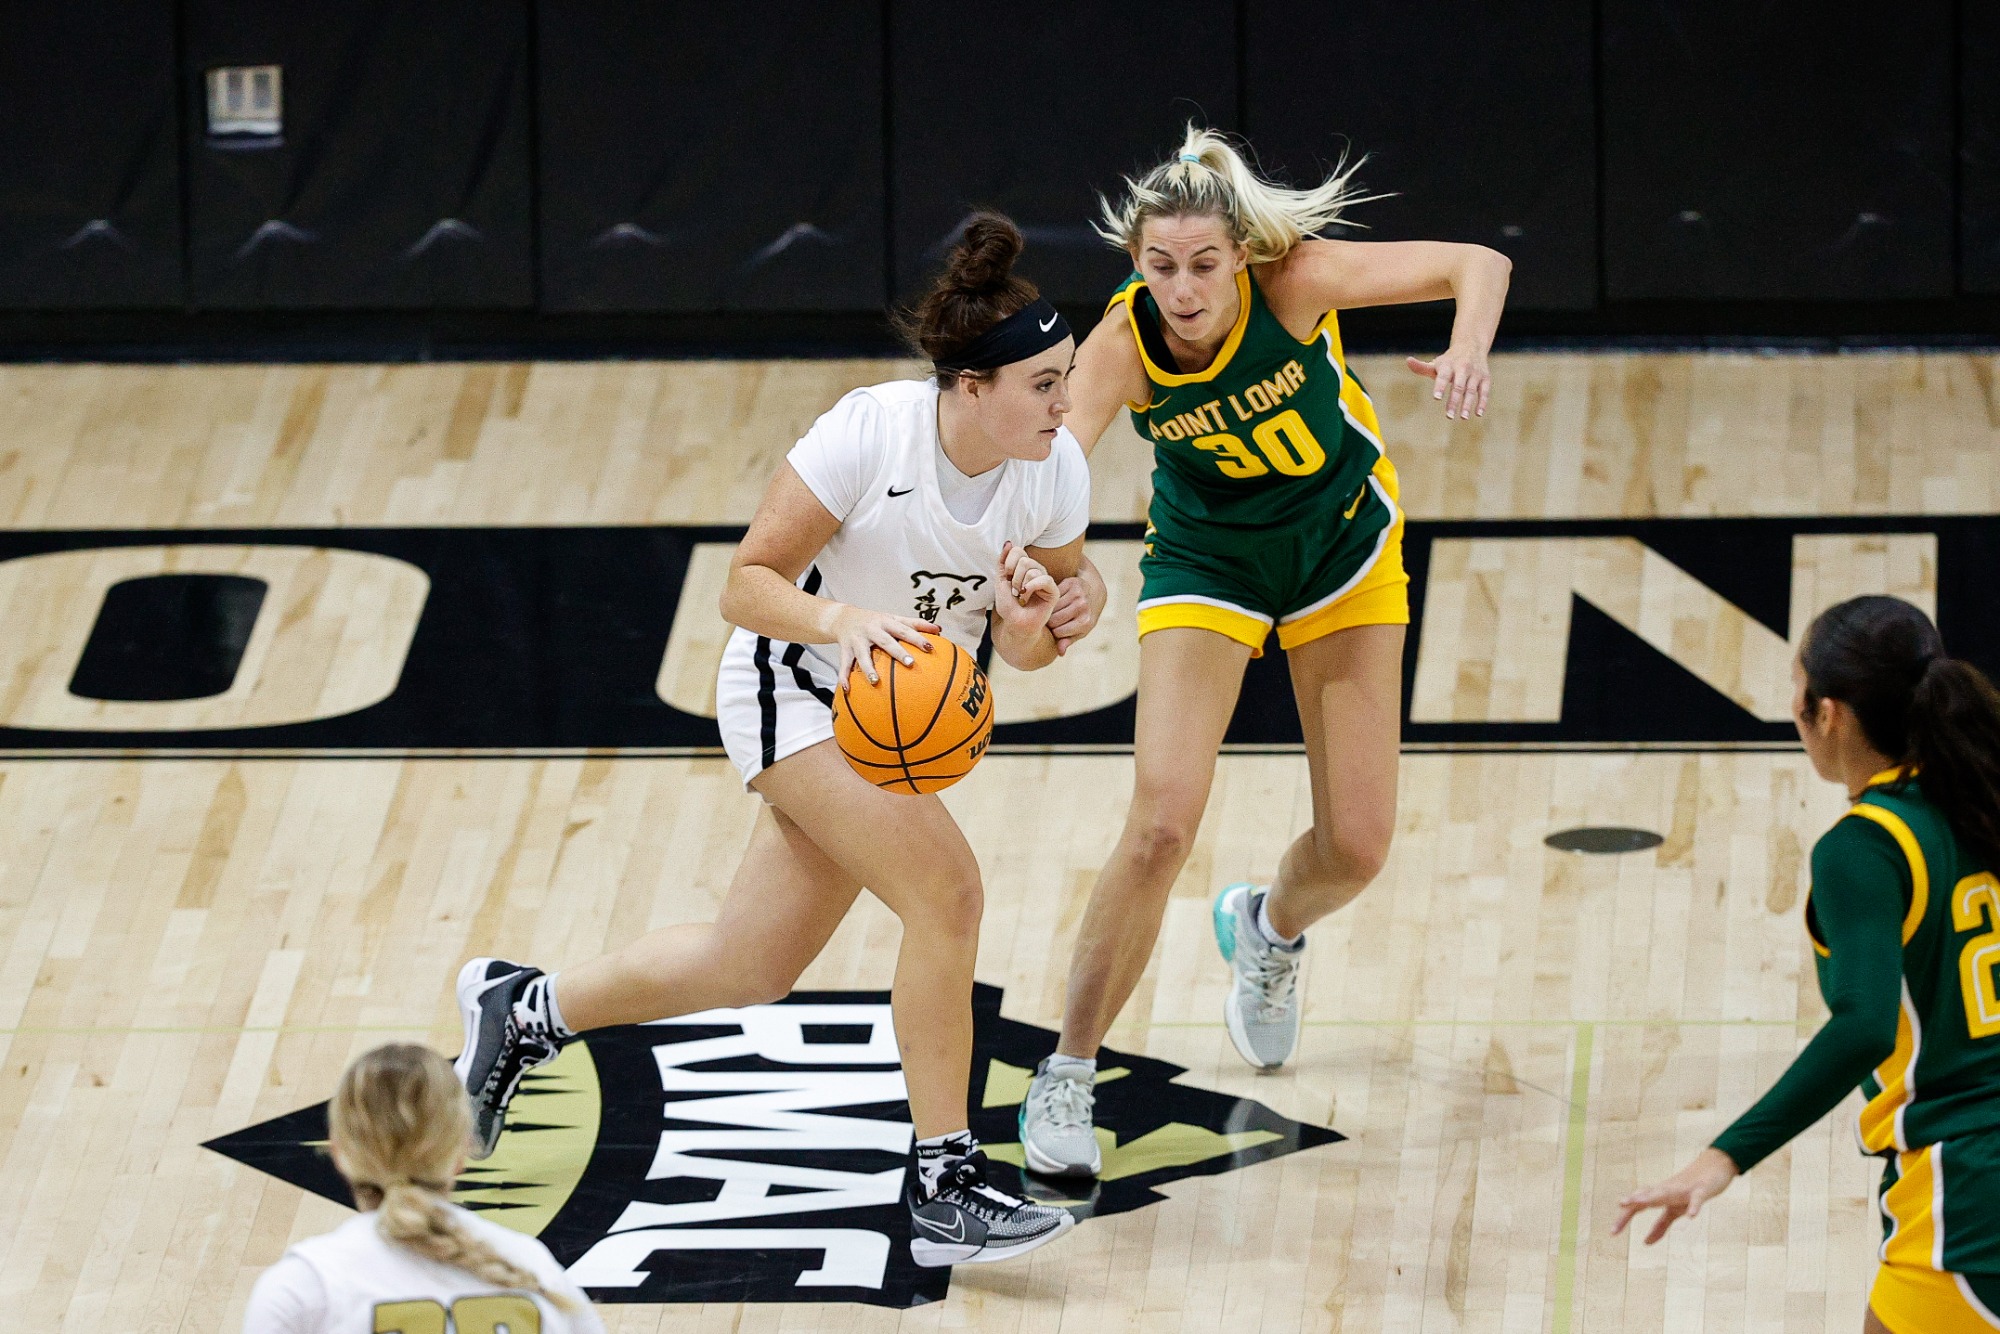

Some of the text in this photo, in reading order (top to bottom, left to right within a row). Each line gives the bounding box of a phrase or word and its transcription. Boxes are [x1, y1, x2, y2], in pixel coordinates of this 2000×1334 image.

[1149, 360, 1307, 442] POINT LOMA
[1192, 409, 1326, 478] 30
[961, 661, 988, 719] CAA
[564, 1003, 915, 1290] RMAC
